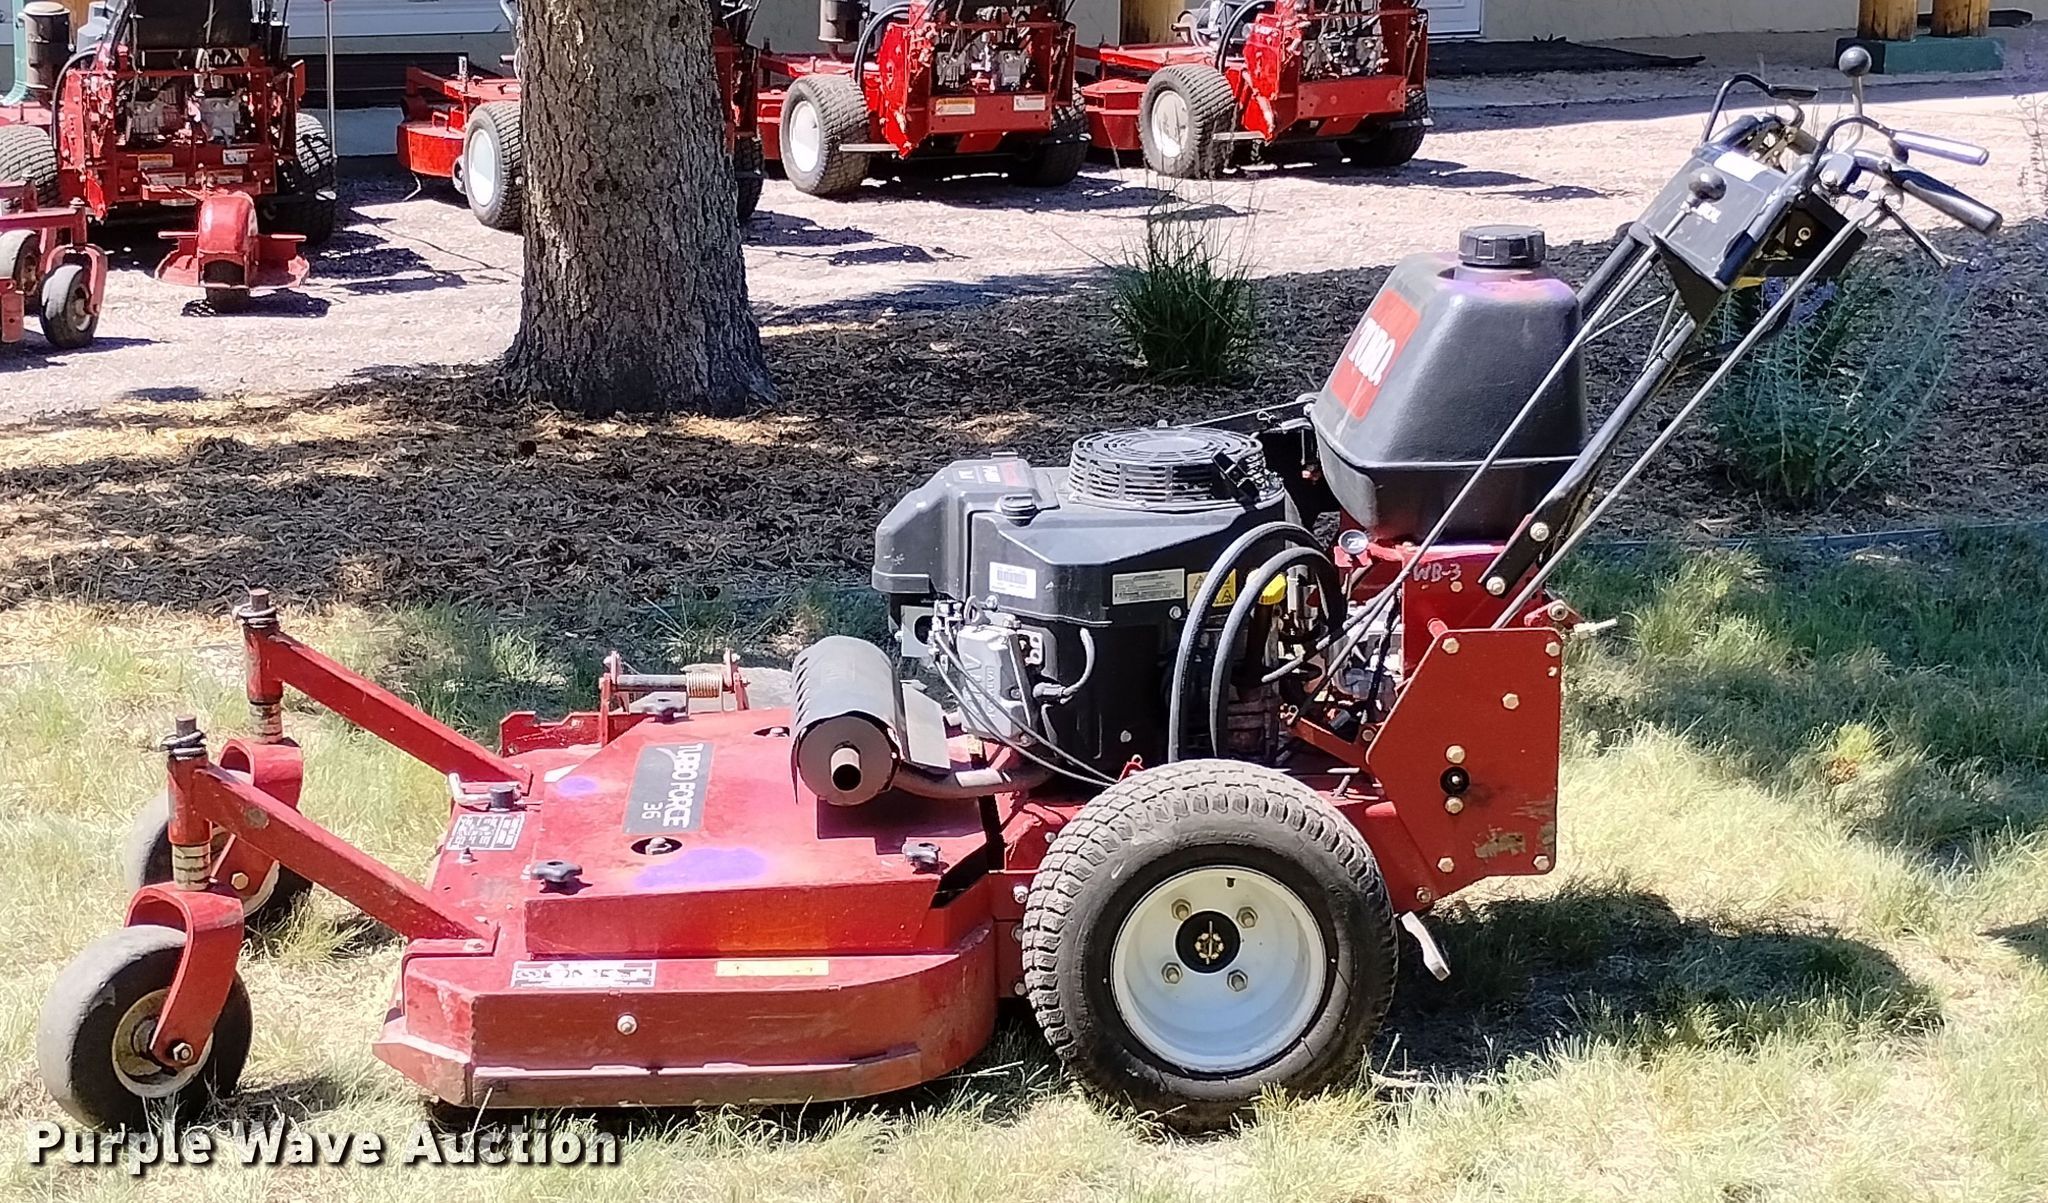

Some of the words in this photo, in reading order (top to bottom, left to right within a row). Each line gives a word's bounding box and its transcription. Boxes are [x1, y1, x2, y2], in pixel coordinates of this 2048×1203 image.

[1413, 562, 1461, 582] WB-3
[641, 802, 663, 819] 36
[662, 782, 696, 828] FORCE
